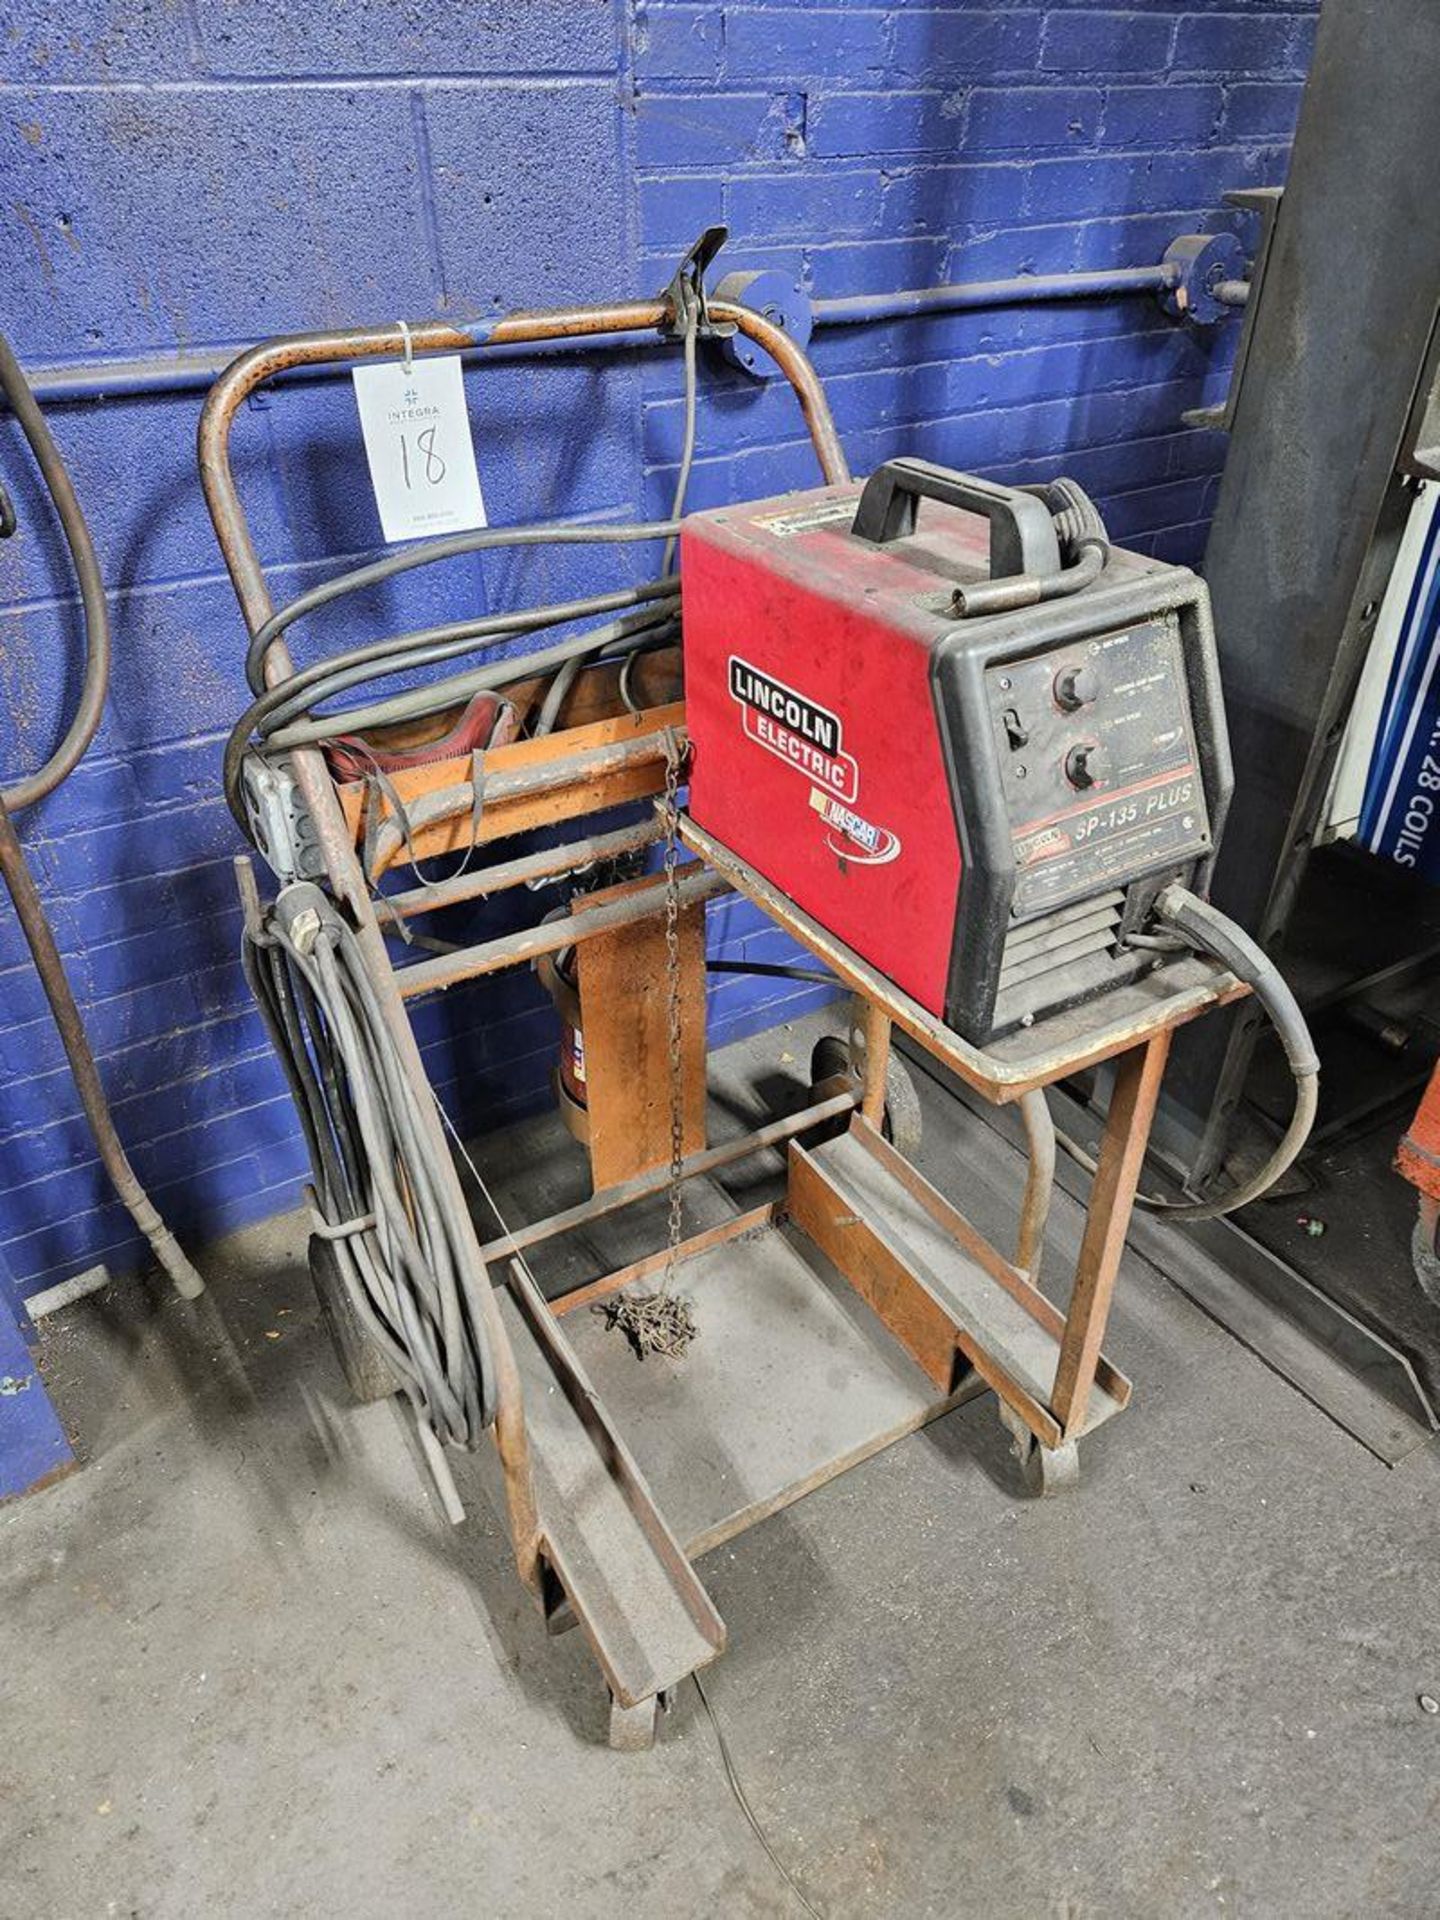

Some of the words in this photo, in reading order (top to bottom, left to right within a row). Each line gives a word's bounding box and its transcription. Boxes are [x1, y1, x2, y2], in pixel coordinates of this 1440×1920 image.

[388, 405, 440, 420] INTEGRA
[400, 423, 446, 490] 18
[735, 667, 833, 749] LINCOLN
[757, 714, 846, 789] ELECTRIC
[1417, 754, 1440, 791] 28
[1075, 803, 1138, 841] SP-135
[1145, 782, 1193, 815] PLUS
[1393, 795, 1434, 868] COILS
